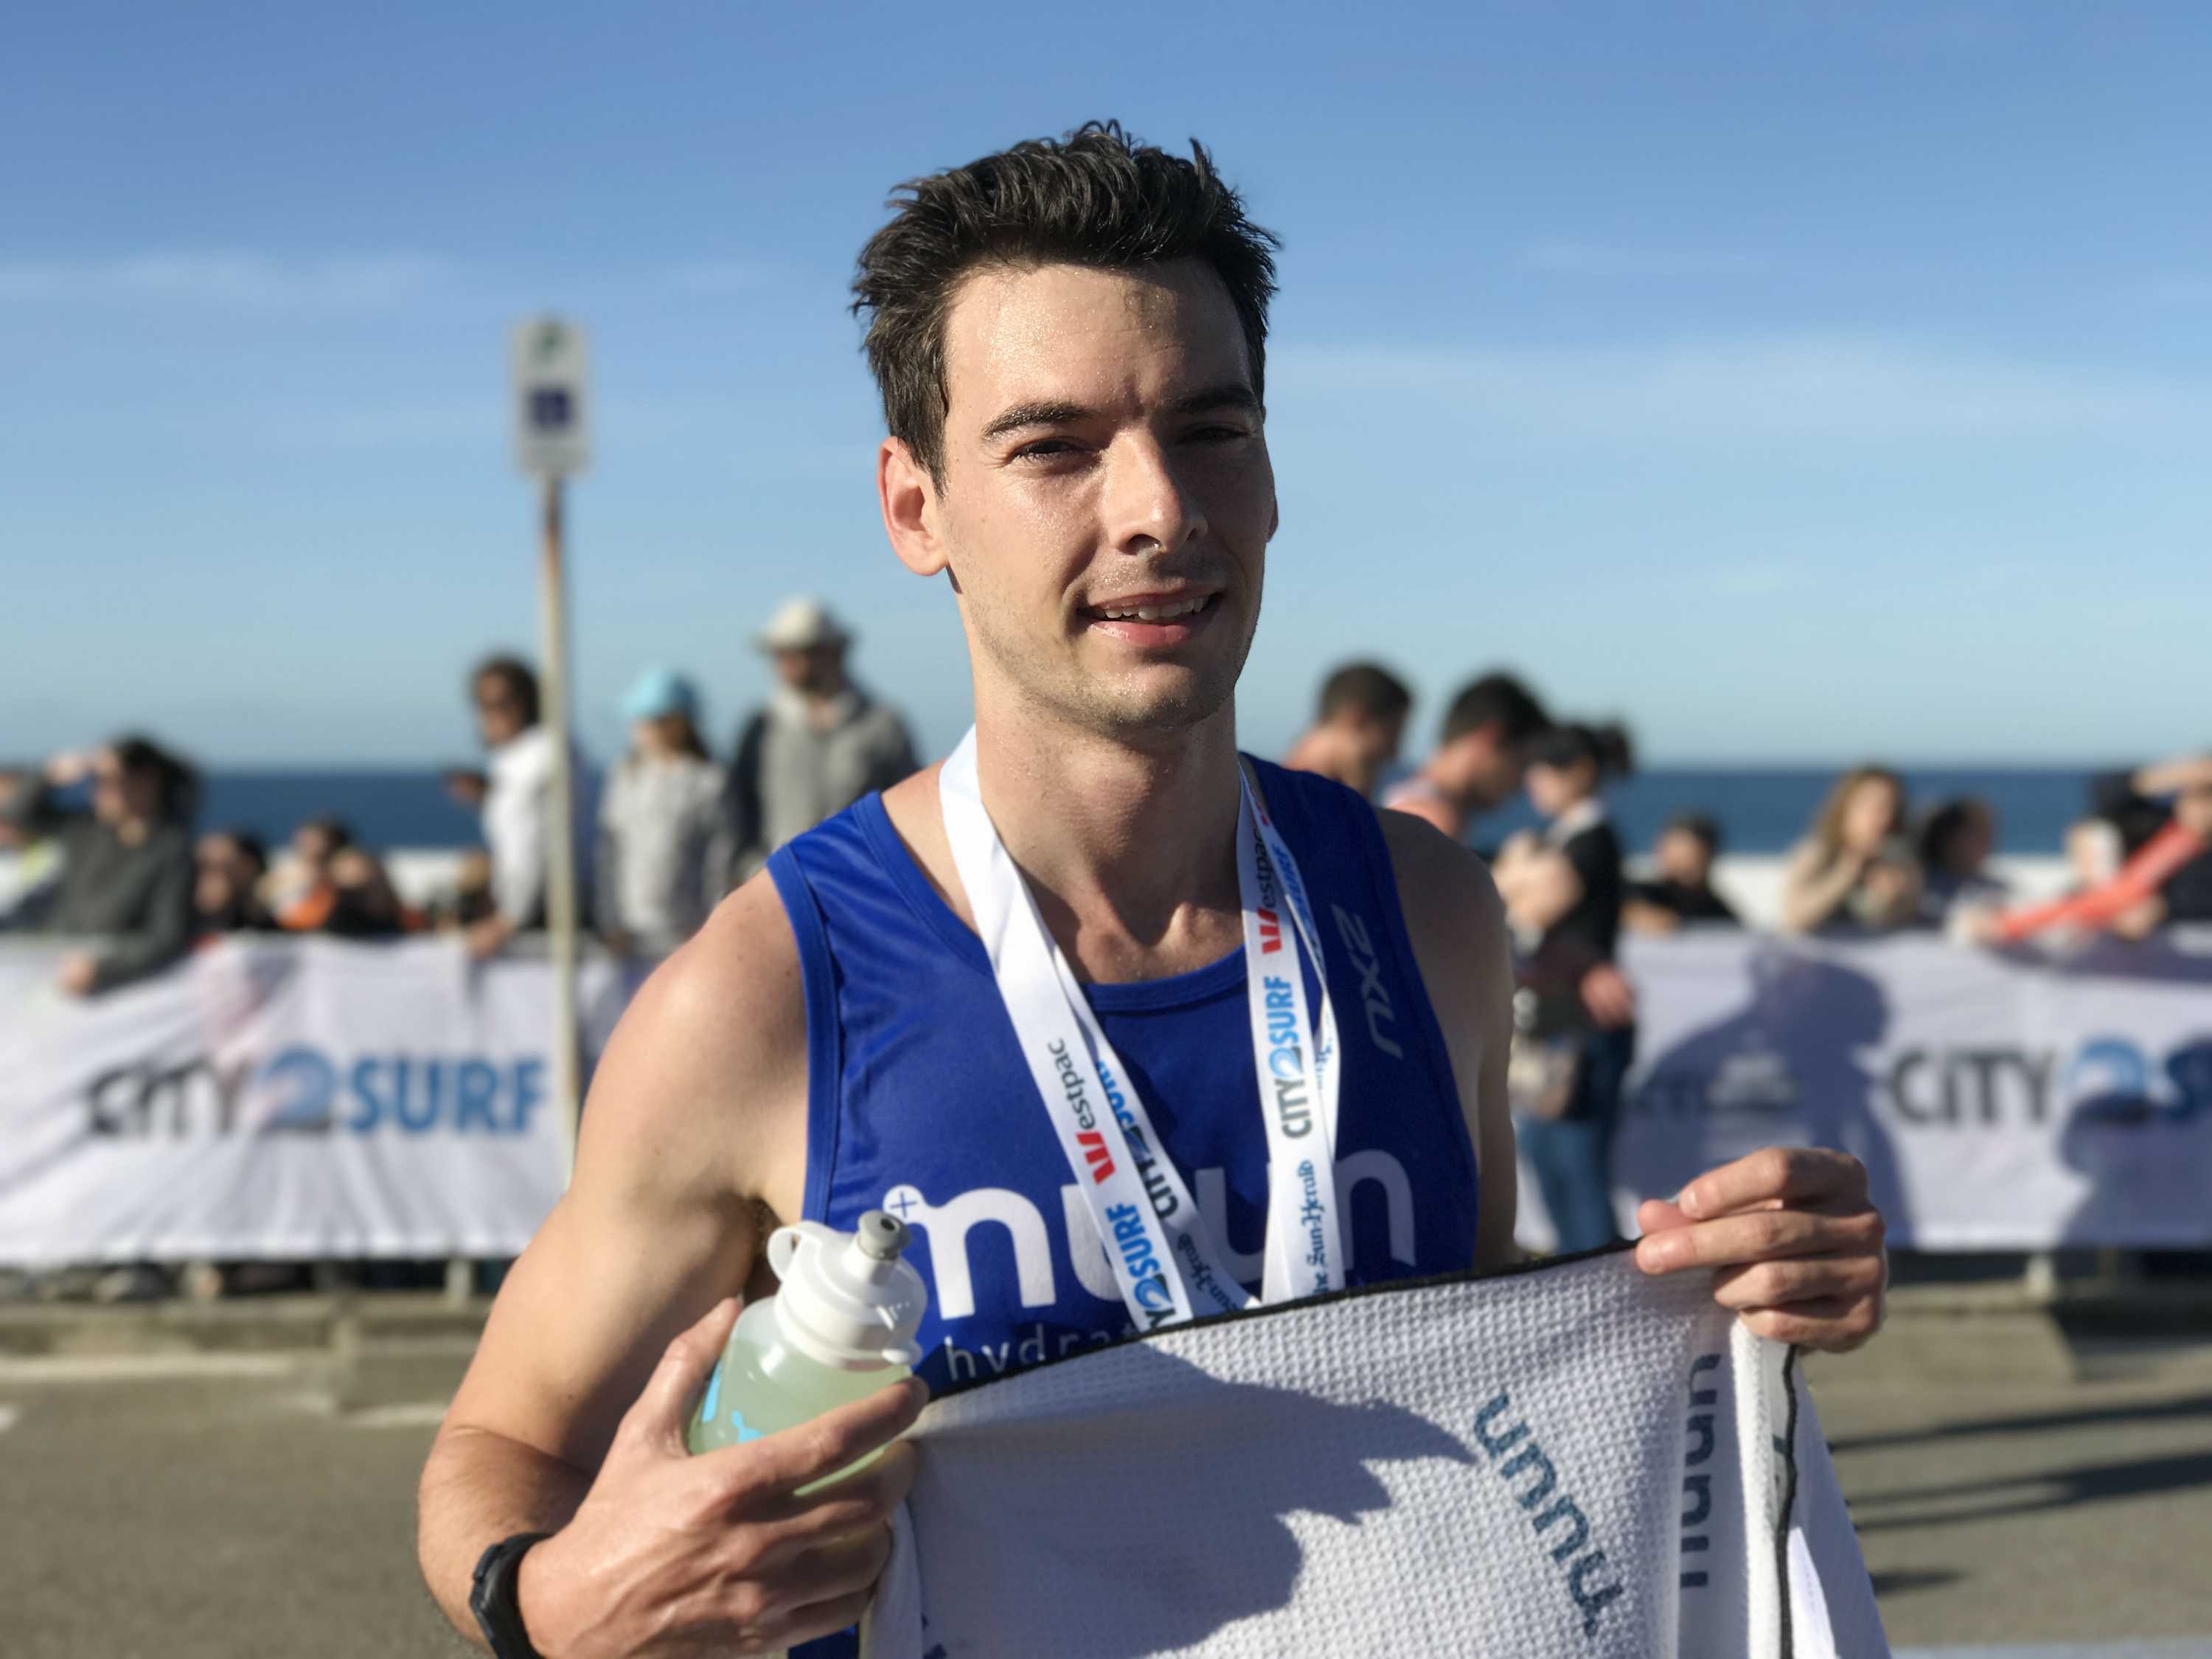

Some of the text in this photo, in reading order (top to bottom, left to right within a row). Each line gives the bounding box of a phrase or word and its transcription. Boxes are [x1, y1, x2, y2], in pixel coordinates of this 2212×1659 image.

[1263, 975, 1312, 1139] CITY2SURF
[1330, 903, 1405, 1060] 2XU
[1047, 1037, 1116, 1186] Westpac
[1891, 1032, 2212, 1126] CITY2S
[1106, 1203, 1177, 1326] Y2SURF
[1474, 1391, 1624, 1638] nuun
